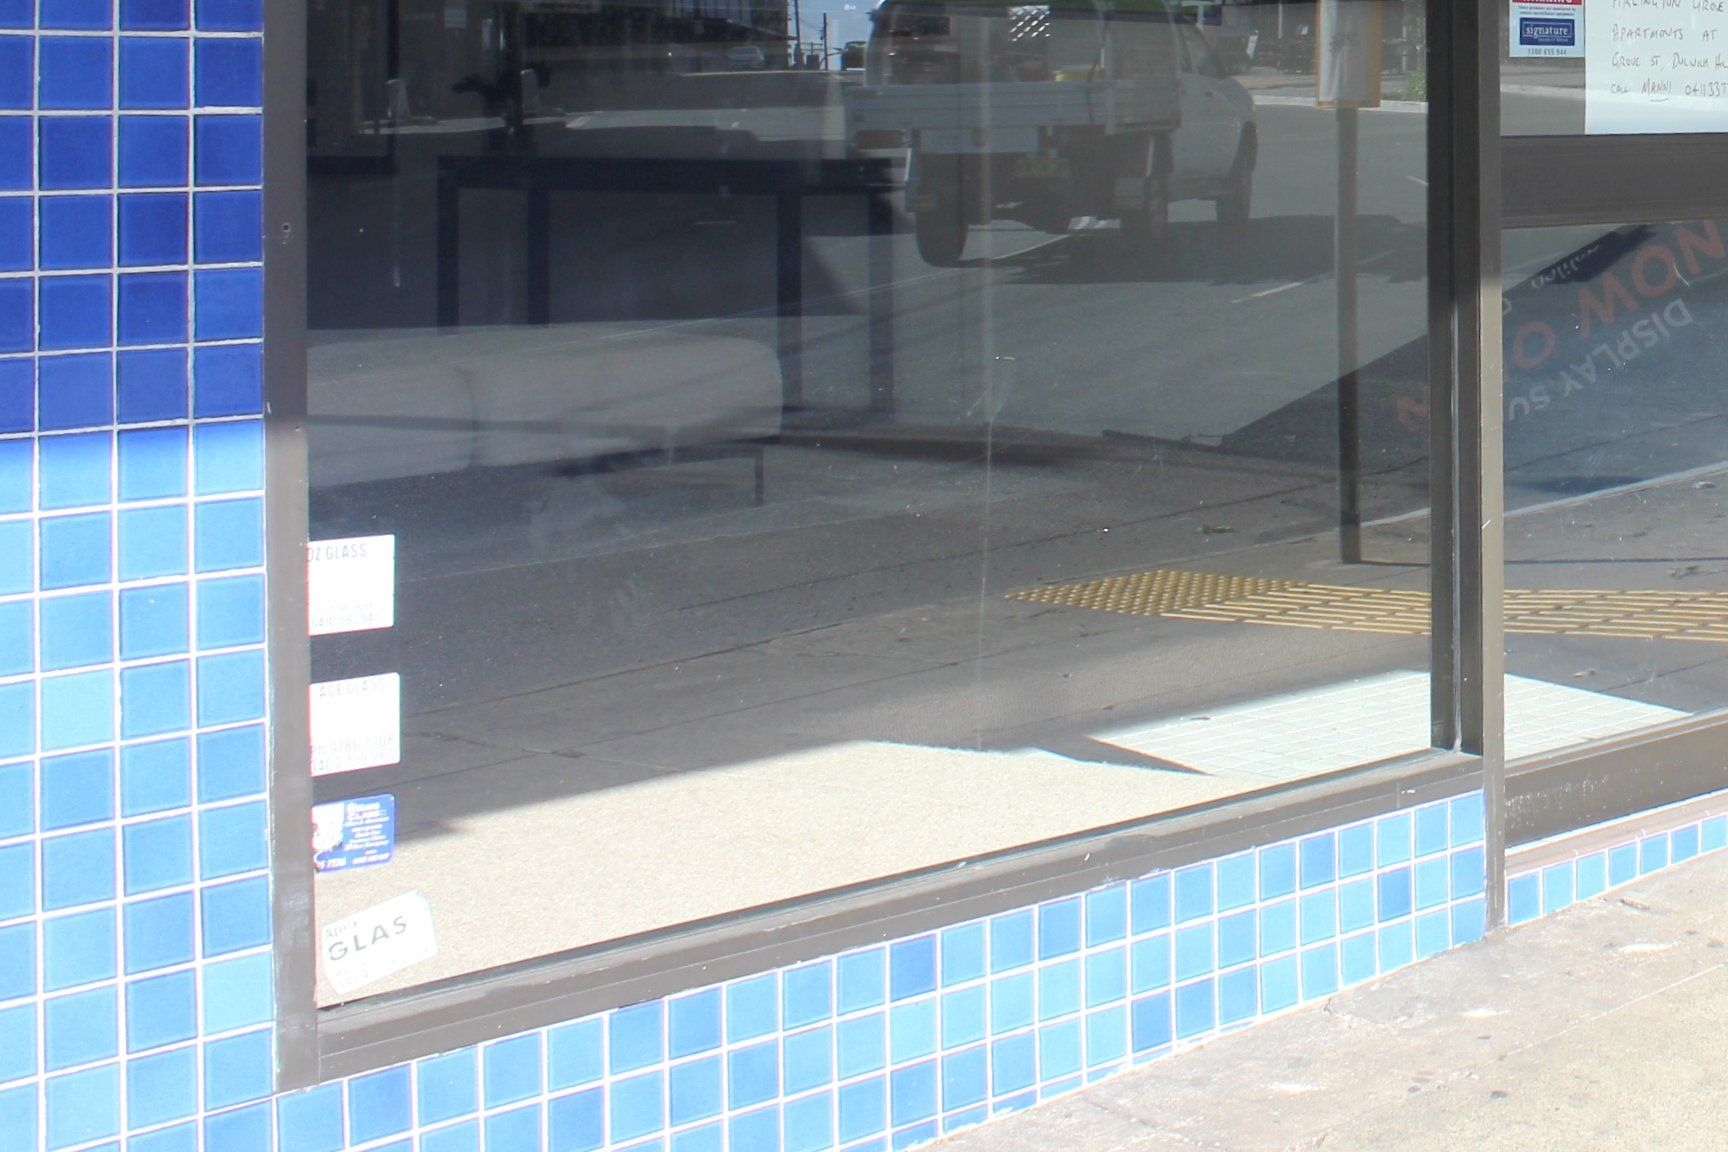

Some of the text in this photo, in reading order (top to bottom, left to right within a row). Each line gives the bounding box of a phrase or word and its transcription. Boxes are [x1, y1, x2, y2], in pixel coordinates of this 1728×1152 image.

[1526, 24, 1568, 39] signature
[1702, 29, 1719, 41] AT
[1612, 51, 1641, 68] GROVE
[1672, 51, 1709, 69] DULWICH
[1610, 83, 1630, 94] CALL
[1580, 219, 1728, 340] NOW
[1564, 297, 1694, 398] DISPLAY
[326, 543, 367, 560] GLASS
[346, 677, 385, 695] GLASS
[328, 915, 407, 961] GLAS
